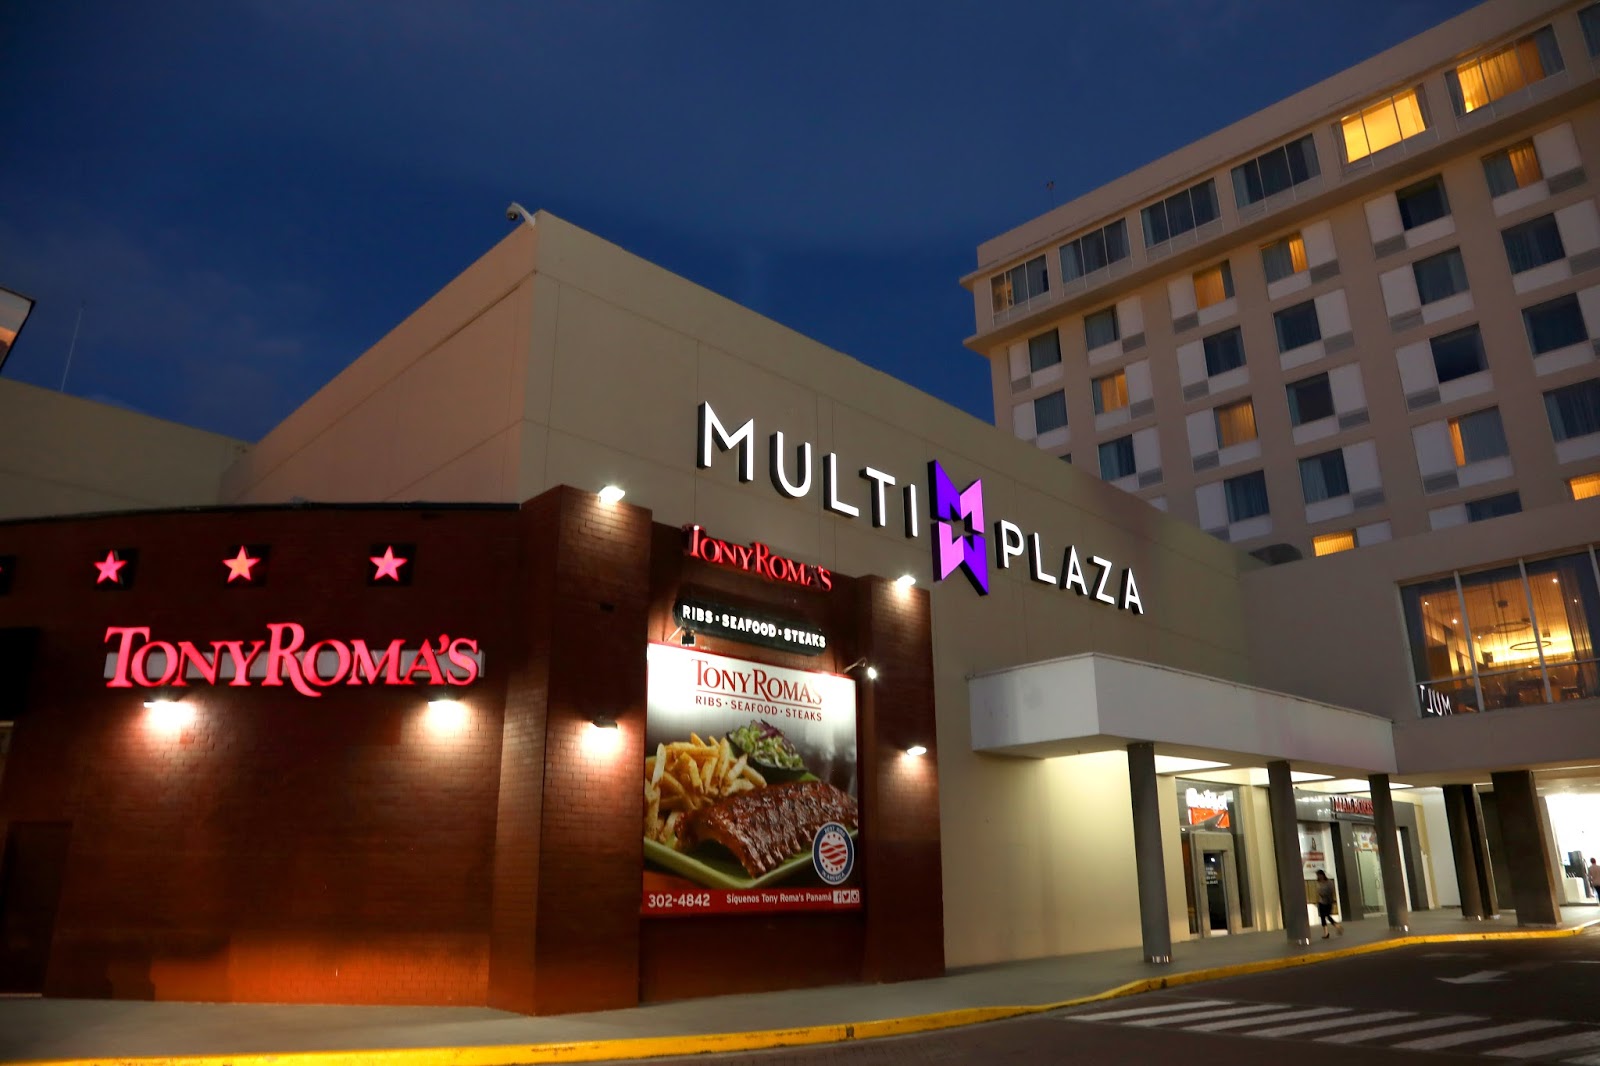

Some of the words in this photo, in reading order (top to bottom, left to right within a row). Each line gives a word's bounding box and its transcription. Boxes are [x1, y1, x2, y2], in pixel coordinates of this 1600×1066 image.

[697, 401, 918, 537] MULTI
[995, 520, 1144, 614] PLAZA
[682, 604, 714, 624] RIBS
[721, 613, 777, 638] SEAFOOD
[783, 627, 826, 649] STEAKS
[695, 695, 722, 708] RIBS
[730, 700, 778, 716] SEAFOOD
[785, 708, 822, 722] STEAKS
[648, 893, 711, 908] 302-4842
[761, 893, 779, 904] Tony
[780, 892, 804, 903] Roma's
[805, 891, 832, 902] Panamá
